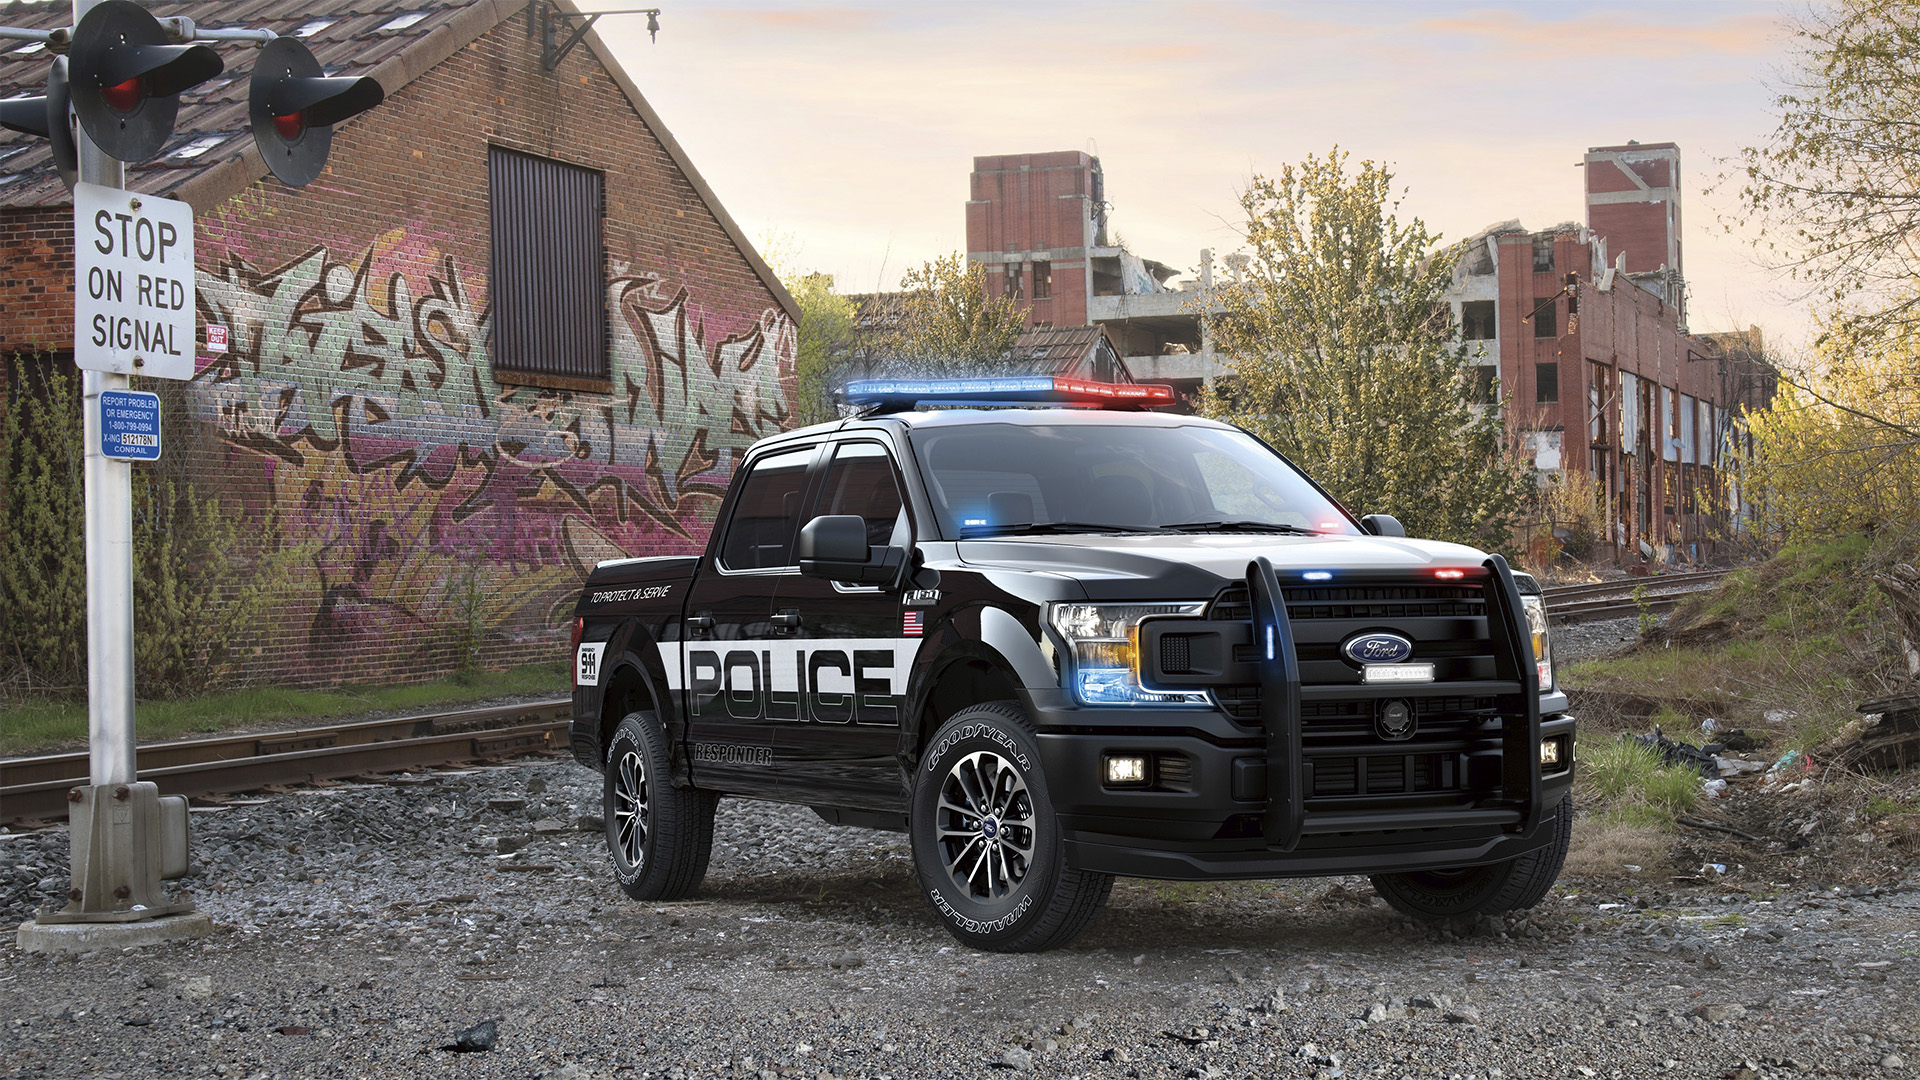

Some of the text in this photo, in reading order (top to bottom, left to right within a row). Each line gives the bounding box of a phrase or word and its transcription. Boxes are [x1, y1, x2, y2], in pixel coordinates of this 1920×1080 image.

[94, 209, 178, 264] STOP
[88, 266, 185, 311] ON RED
[92, 313, 182, 356] SIGNAL
[209, 327, 226, 336] KEEP
[211, 335, 224, 343] OUT
[102, 396, 157, 409] REPORT PROBLEM
[106, 408, 154, 420] OR EMERGENCY
[108, 420, 152, 431] 1-800-799-0994
[103, 433, 153, 445] X-ING 512178N
[114, 445, 147, 454] CONRAIL
[590, 585, 672, 603] TO PROTECT & SERVE
[1363, 640, 1398, 658] Ford
[688, 649, 899, 727] POLICE
[695, 743, 773, 766] RESPONDER
[927, 723, 1032, 772] GOODYEAR
[930, 888, 1033, 934] WRANGLER
